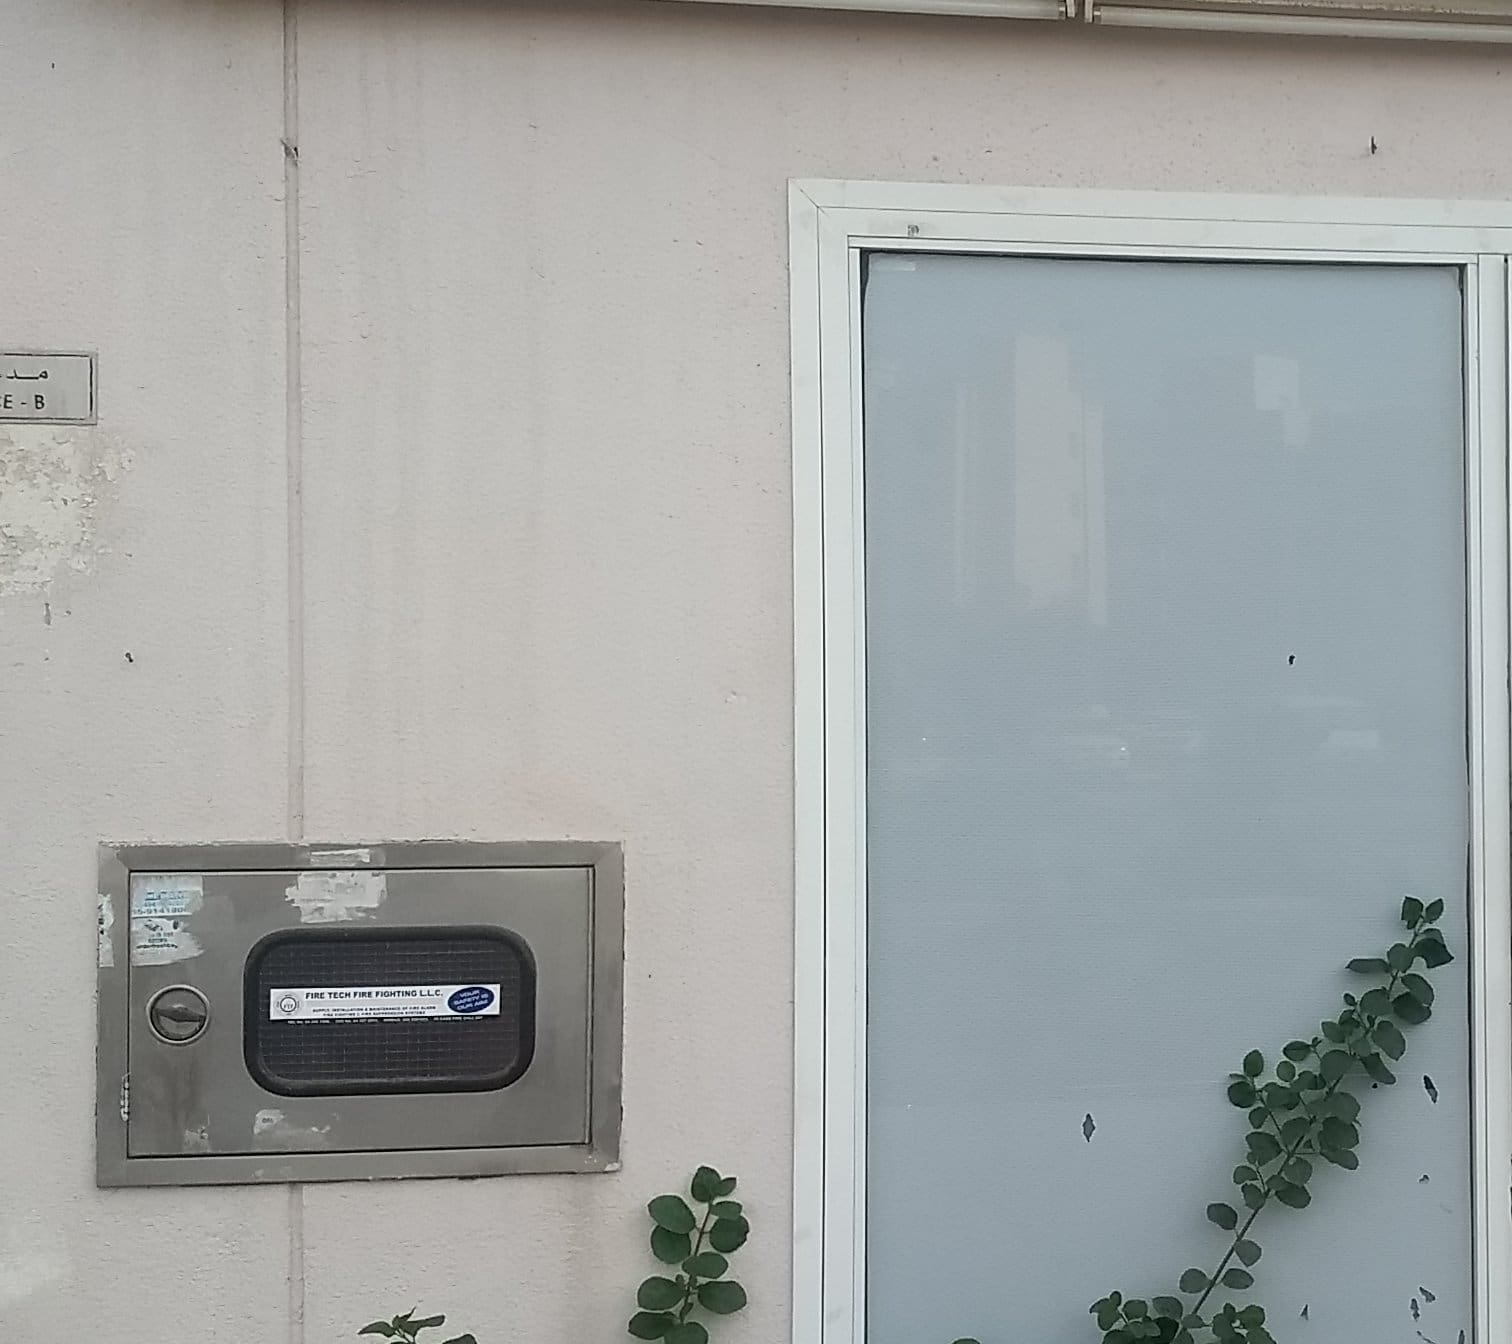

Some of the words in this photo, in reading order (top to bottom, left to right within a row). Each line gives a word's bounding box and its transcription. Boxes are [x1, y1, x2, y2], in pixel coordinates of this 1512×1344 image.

[34, 394, 46, 410] B
[327, 991, 351, 999] TECH
[353, 991, 372, 999] FIRE
[375, 990, 417, 998] FIGHTING
[419, 989, 444, 997] L.L.C.
